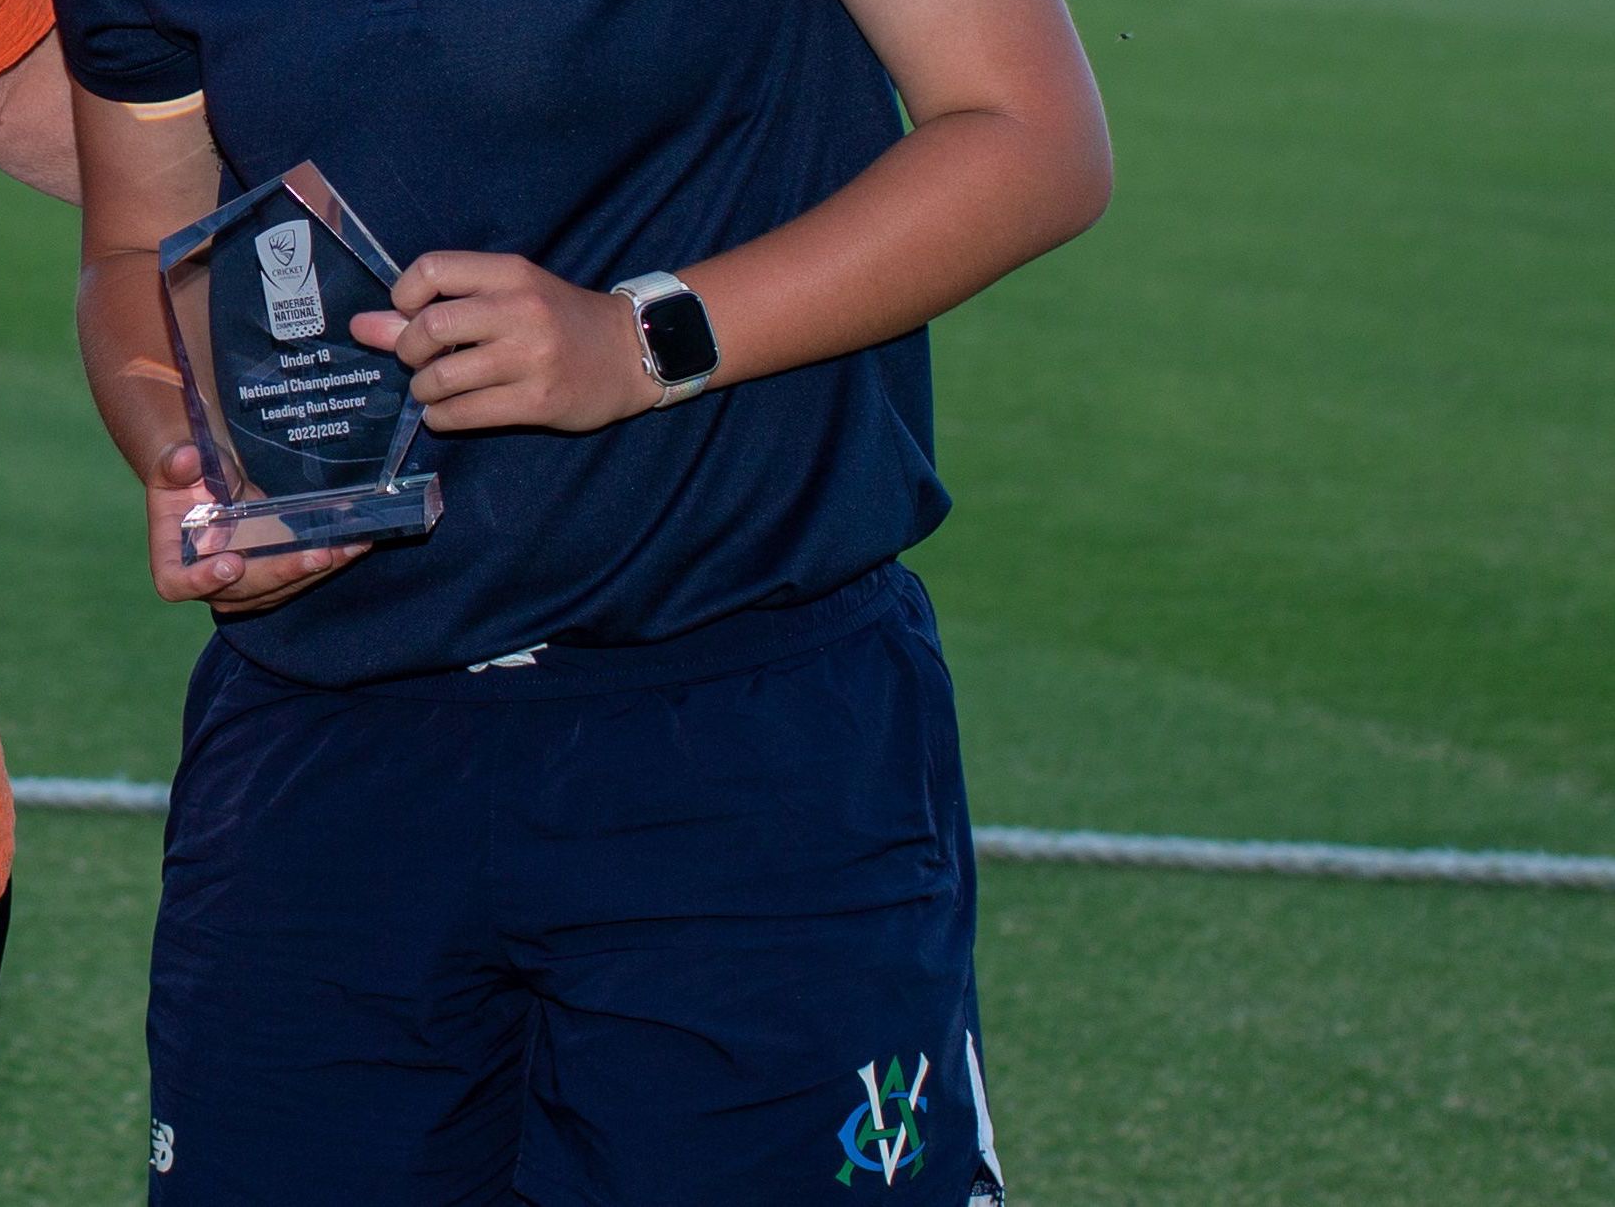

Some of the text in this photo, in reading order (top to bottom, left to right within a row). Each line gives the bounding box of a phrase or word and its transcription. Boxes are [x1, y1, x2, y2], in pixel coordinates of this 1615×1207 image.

[272, 265, 303, 277] CRICKET
[272, 295, 316, 311] UNDERAGE
[273, 307, 318, 323] NATIONAL
[280, 348, 330, 368] Under 19
[238, 368, 381, 400] National Championships
[261, 396, 367, 420] Leading Run Scorer
[287, 421, 350, 442] 2022/2023
